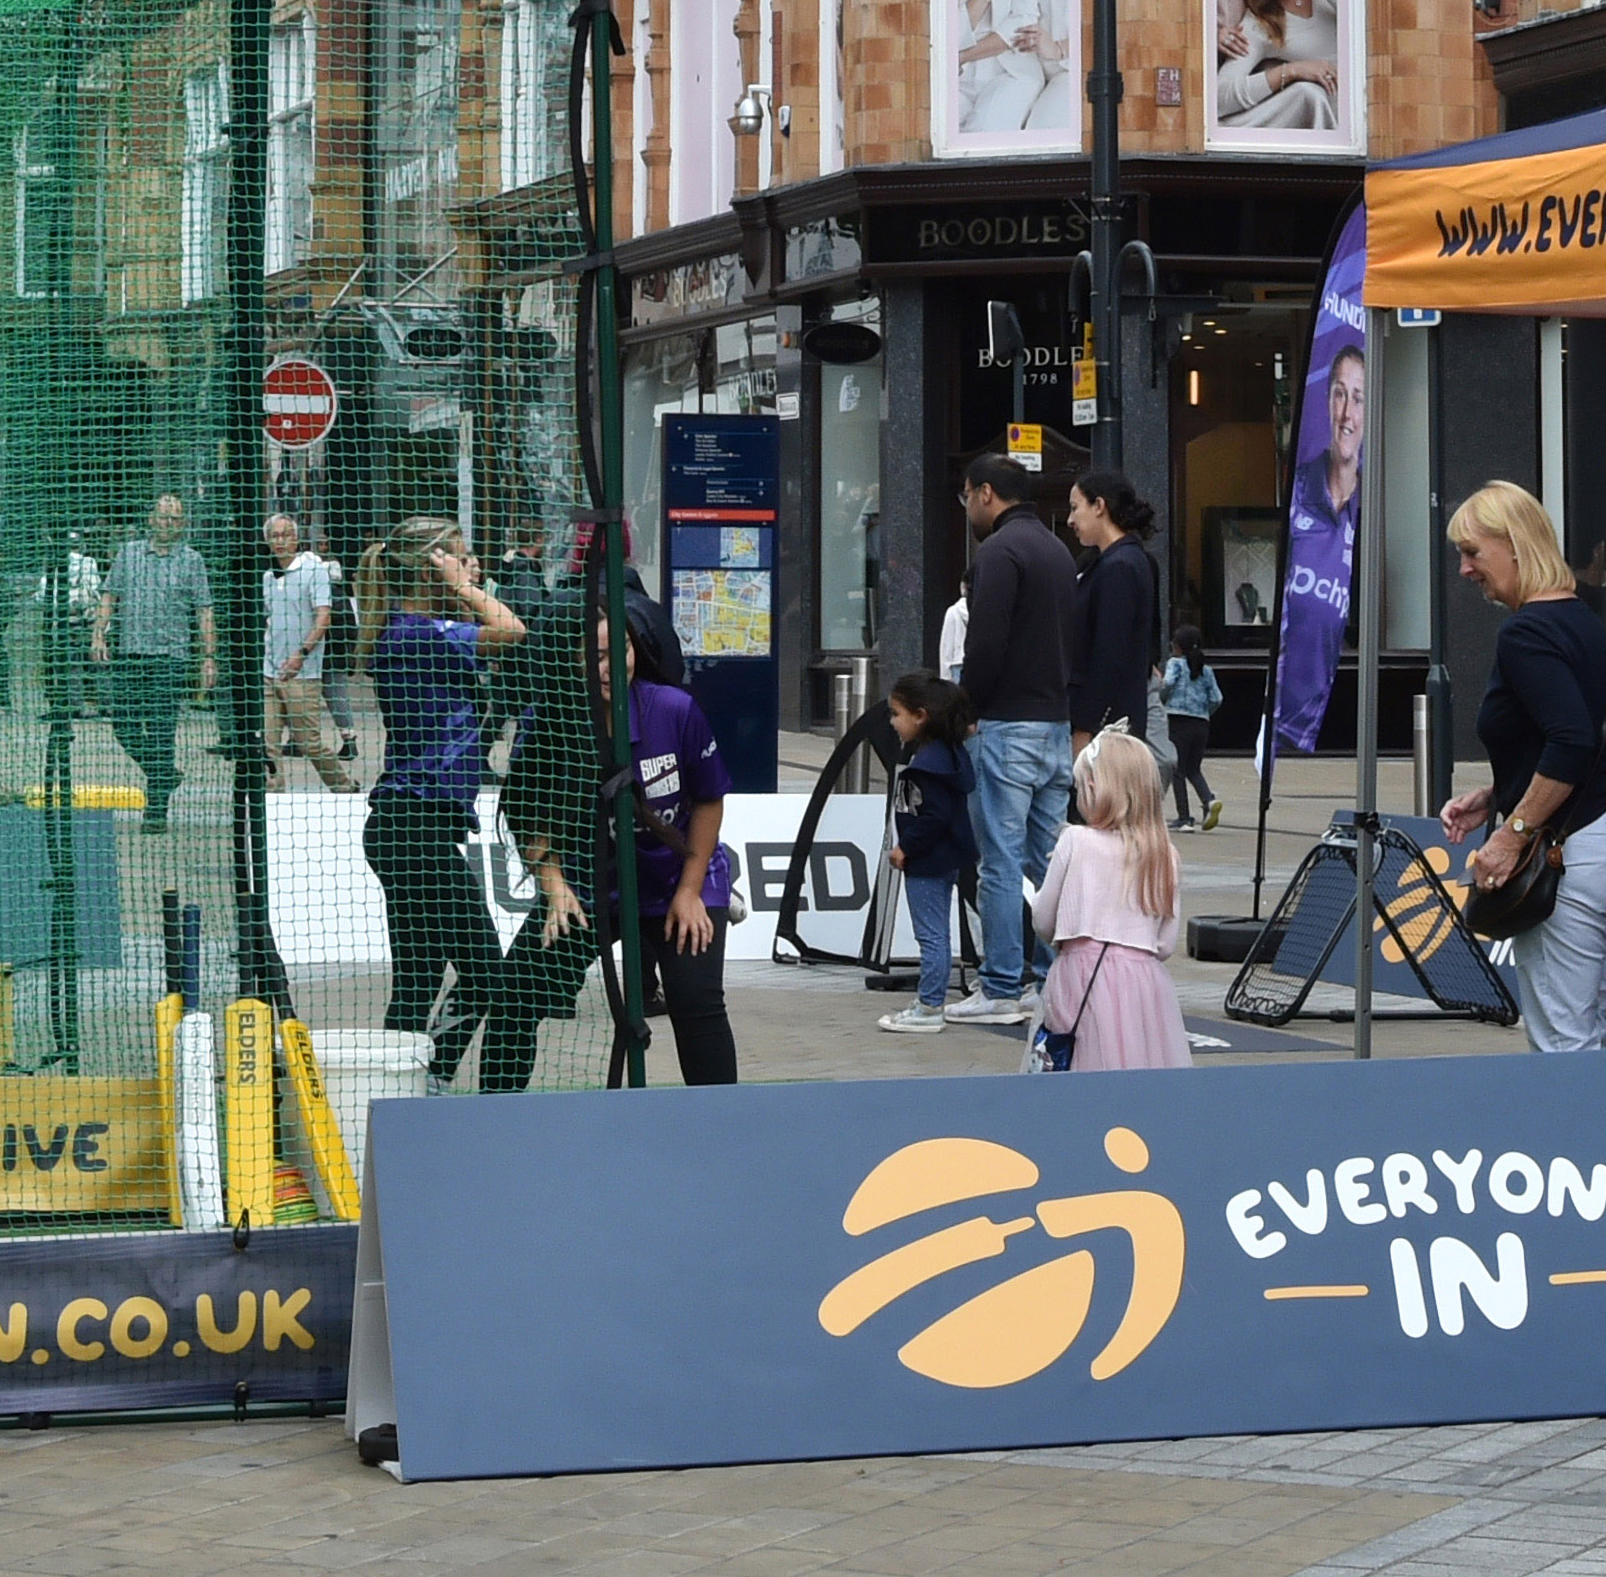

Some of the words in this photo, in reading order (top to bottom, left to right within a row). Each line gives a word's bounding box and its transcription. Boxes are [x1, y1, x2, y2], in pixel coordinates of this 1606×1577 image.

[919, 214, 1086, 248] BOODLES
[1022, 373, 1058, 385] 1798
[639, 753, 677, 782] SUPER
[239, 1012, 257, 1084] ELDERS
[295, 1031, 323, 1100] ELDERS
[1389, 1232, 1529, 1339] IN
